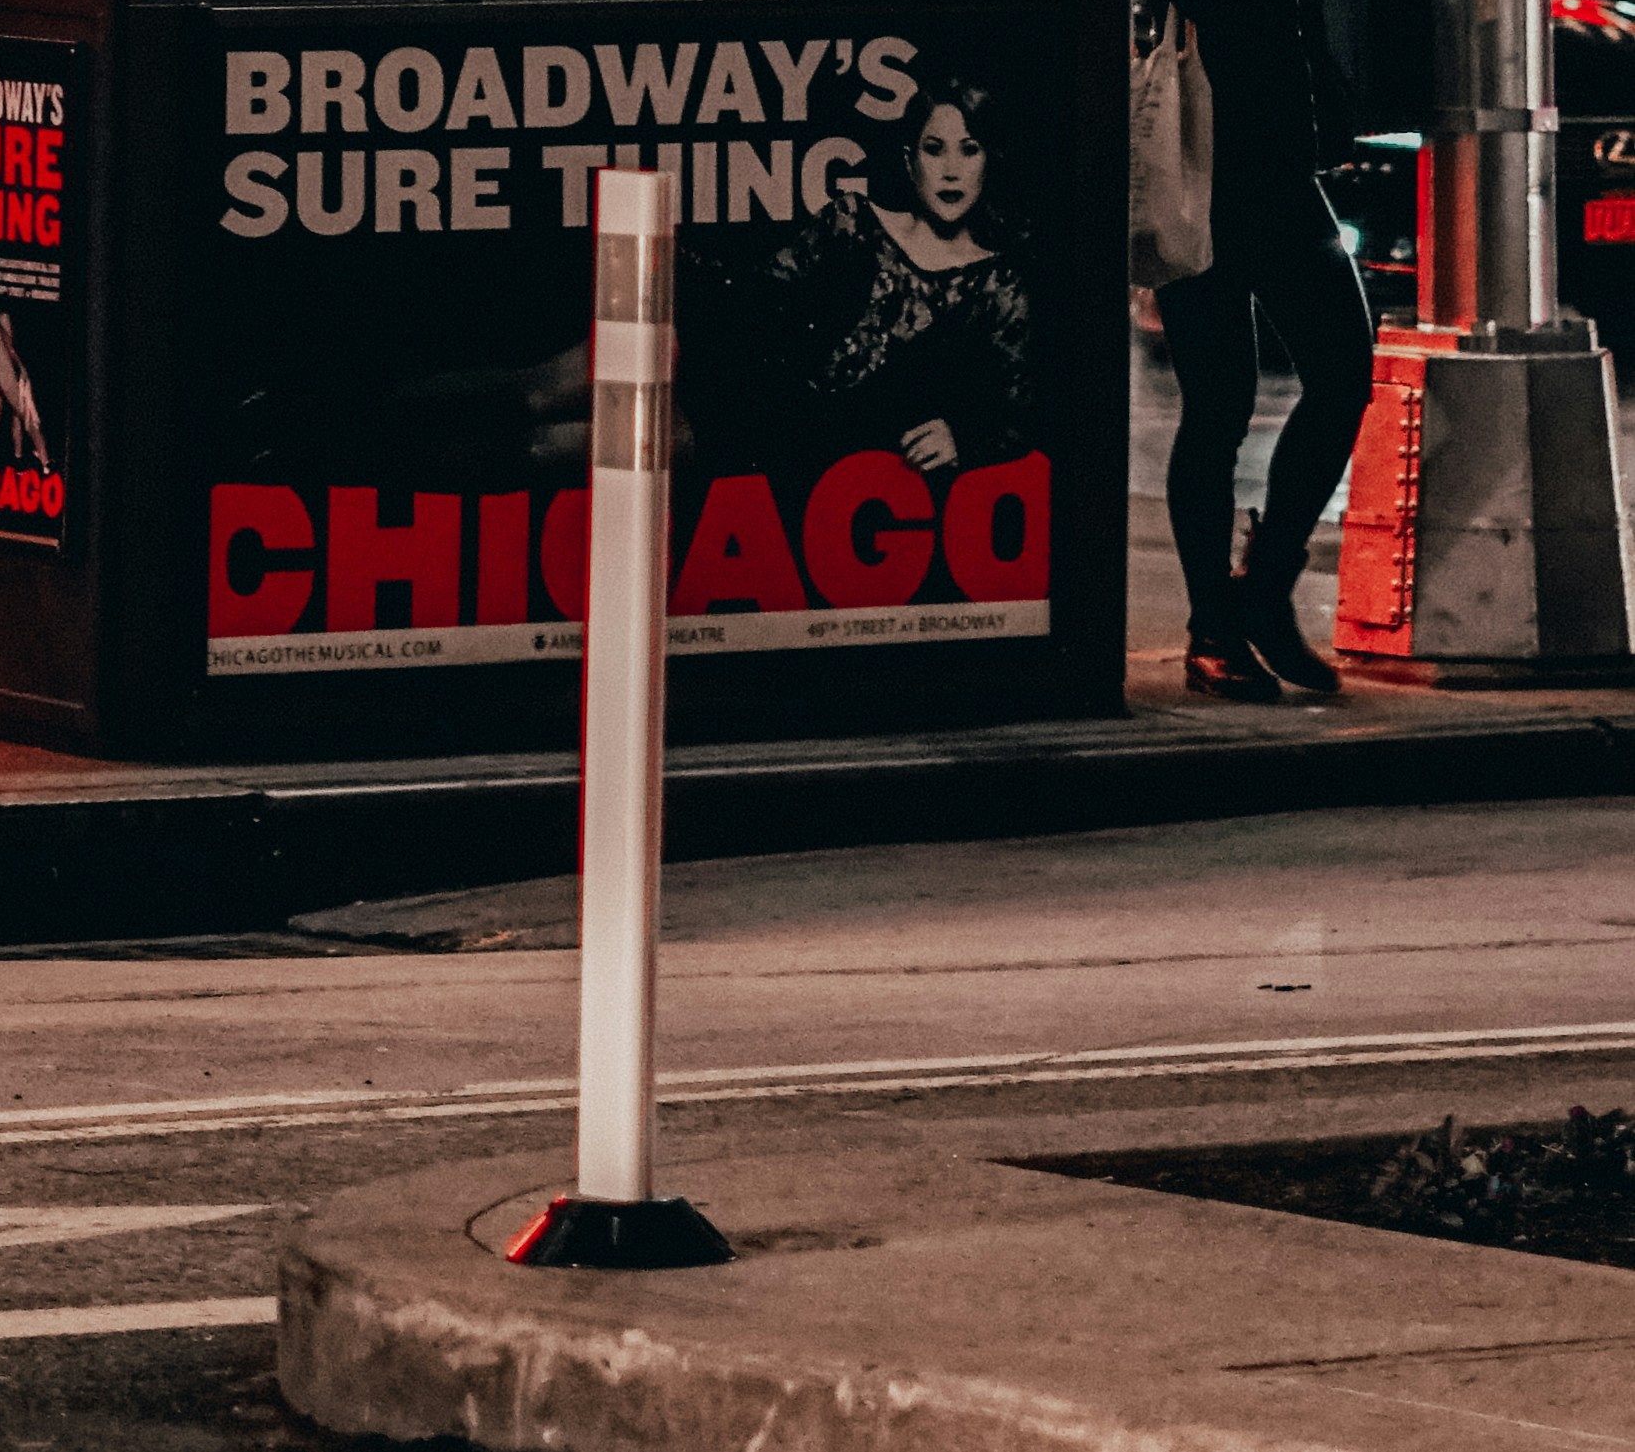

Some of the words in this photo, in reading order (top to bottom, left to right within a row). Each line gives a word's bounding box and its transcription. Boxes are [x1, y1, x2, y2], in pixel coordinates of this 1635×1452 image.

[224, 34, 920, 135] BROADWAY'S
[218, 146, 512, 238] SURE
[918, 612, 1007, 632] BROADWAY
